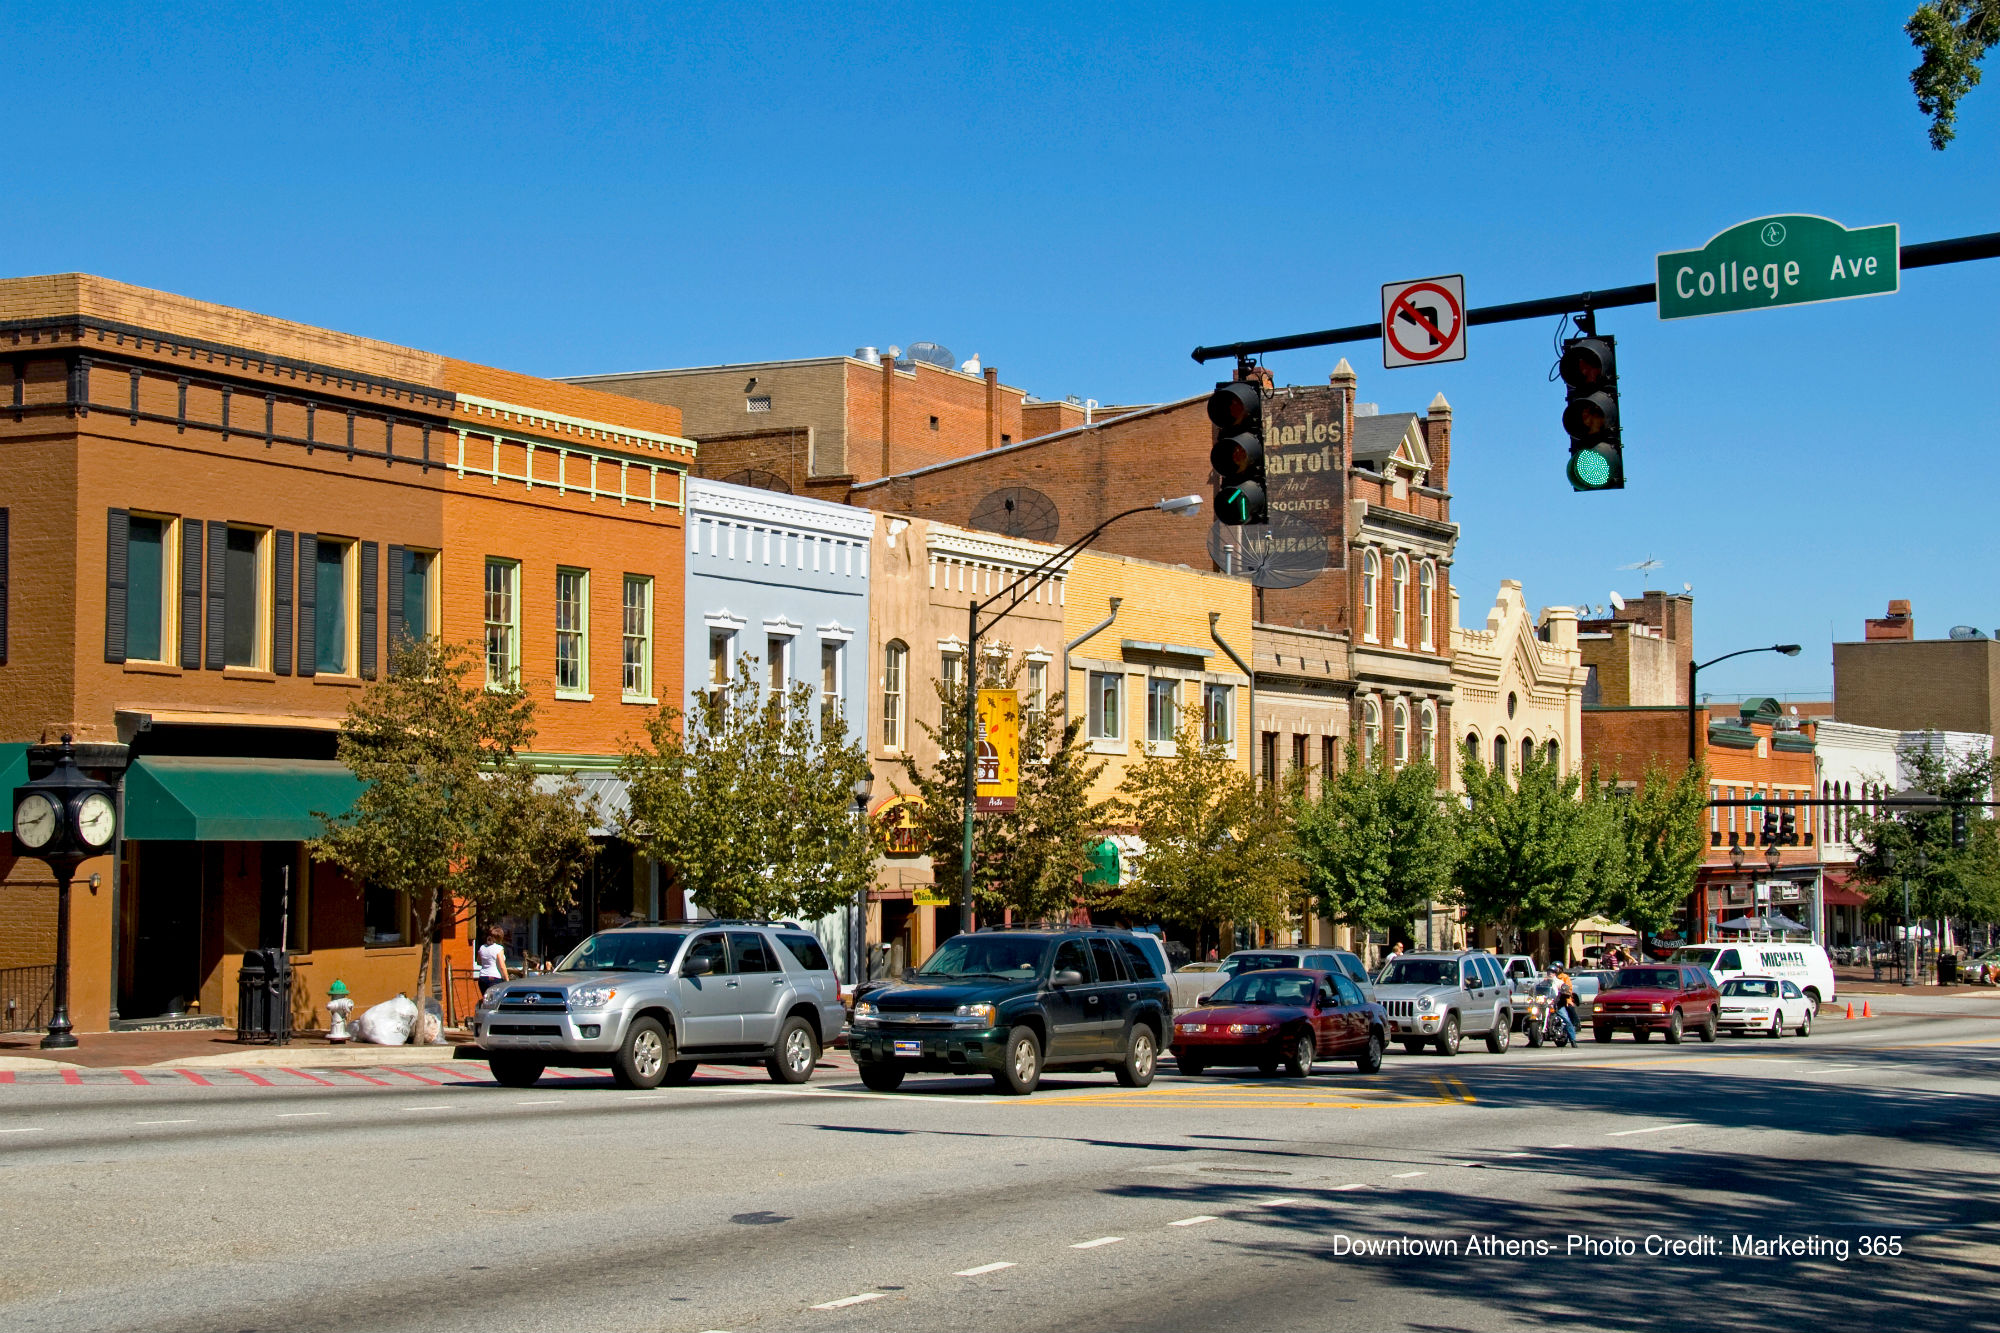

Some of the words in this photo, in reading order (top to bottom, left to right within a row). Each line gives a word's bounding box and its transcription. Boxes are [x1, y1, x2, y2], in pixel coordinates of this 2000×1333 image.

[1676, 261, 1800, 300] College
[1830, 254, 1878, 281] Ave
[1263, 412, 1342, 446] harles
[1265, 444, 1343, 478] arrott
[1267, 499, 1330, 512] SOCIATES
[1760, 952, 1805, 967] MICHAEL
